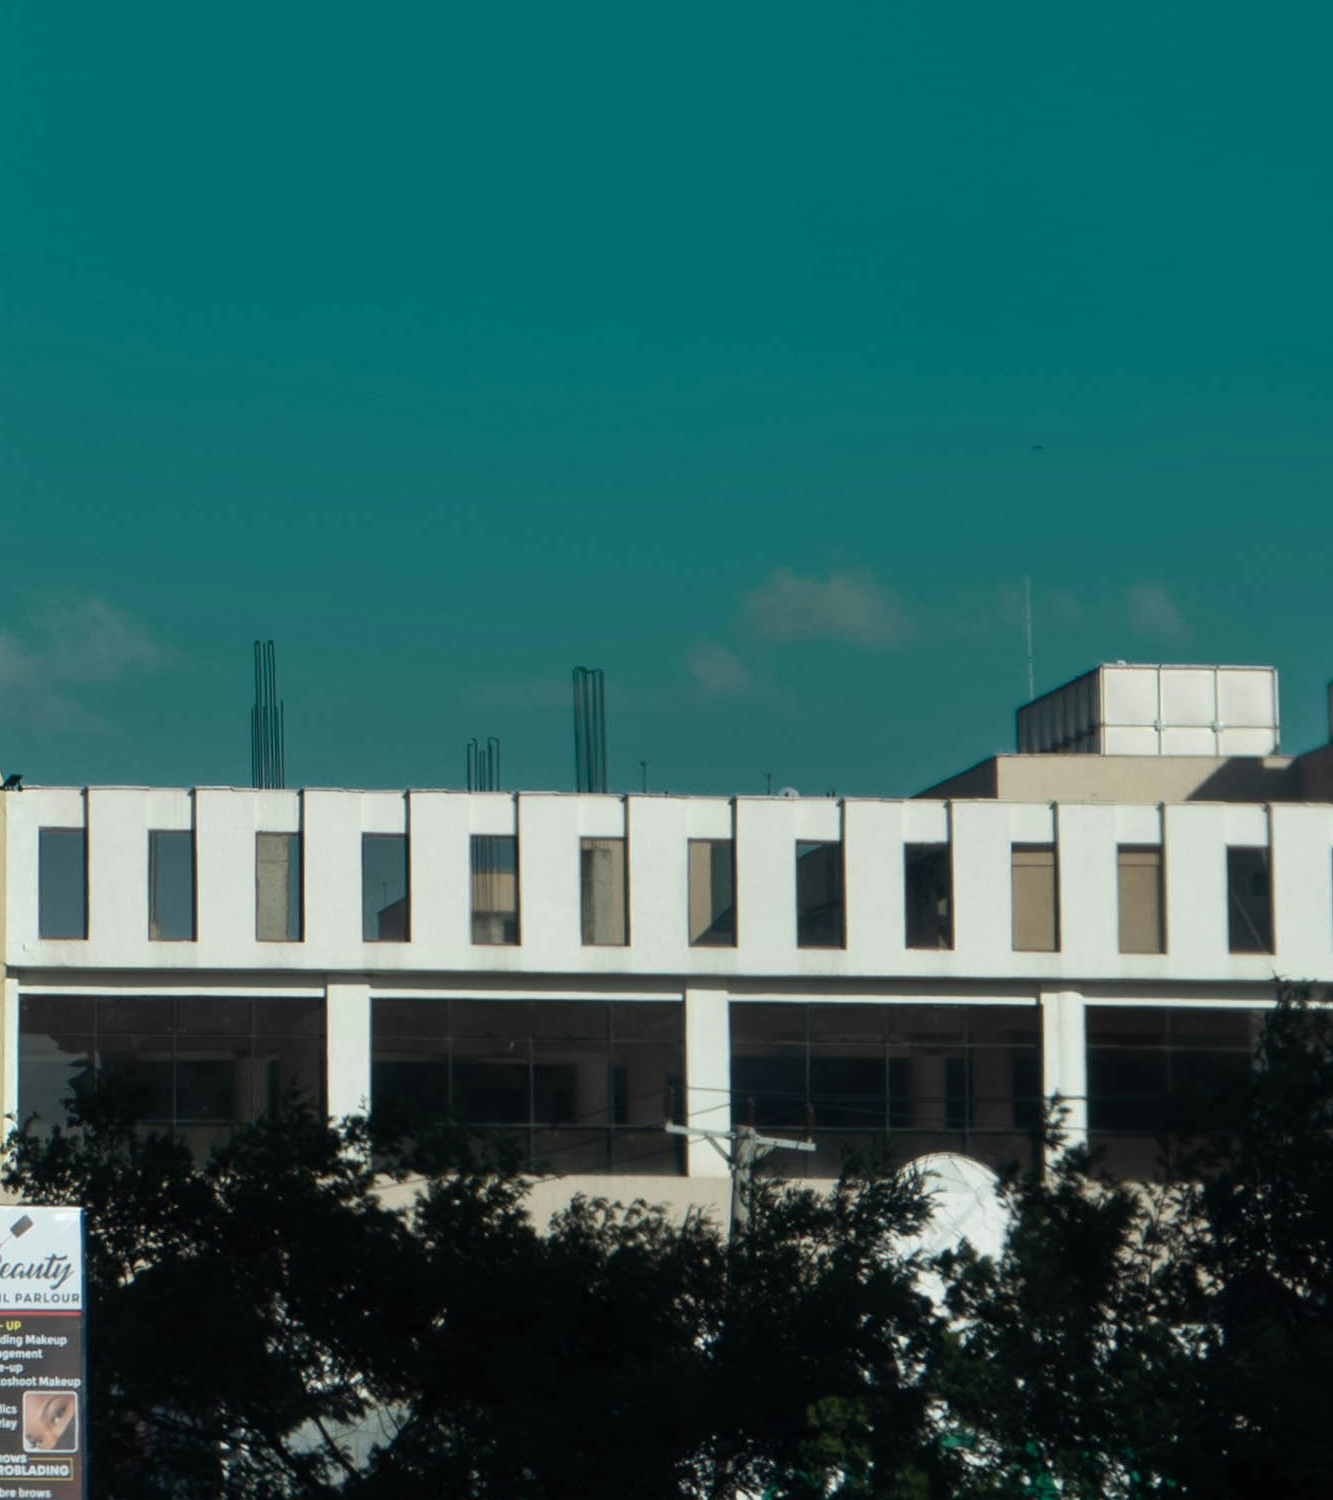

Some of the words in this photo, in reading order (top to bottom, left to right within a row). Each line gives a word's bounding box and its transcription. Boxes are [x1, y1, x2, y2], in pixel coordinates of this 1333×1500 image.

[15, 1293, 80, 1304] PARLOUR
[5, 1320, 21, 1331] UP
[25, 1335, 68, 1347] Makeup
[38, 1376, 81, 1388] Makeup
[18, 1487, 52, 1498] brows
